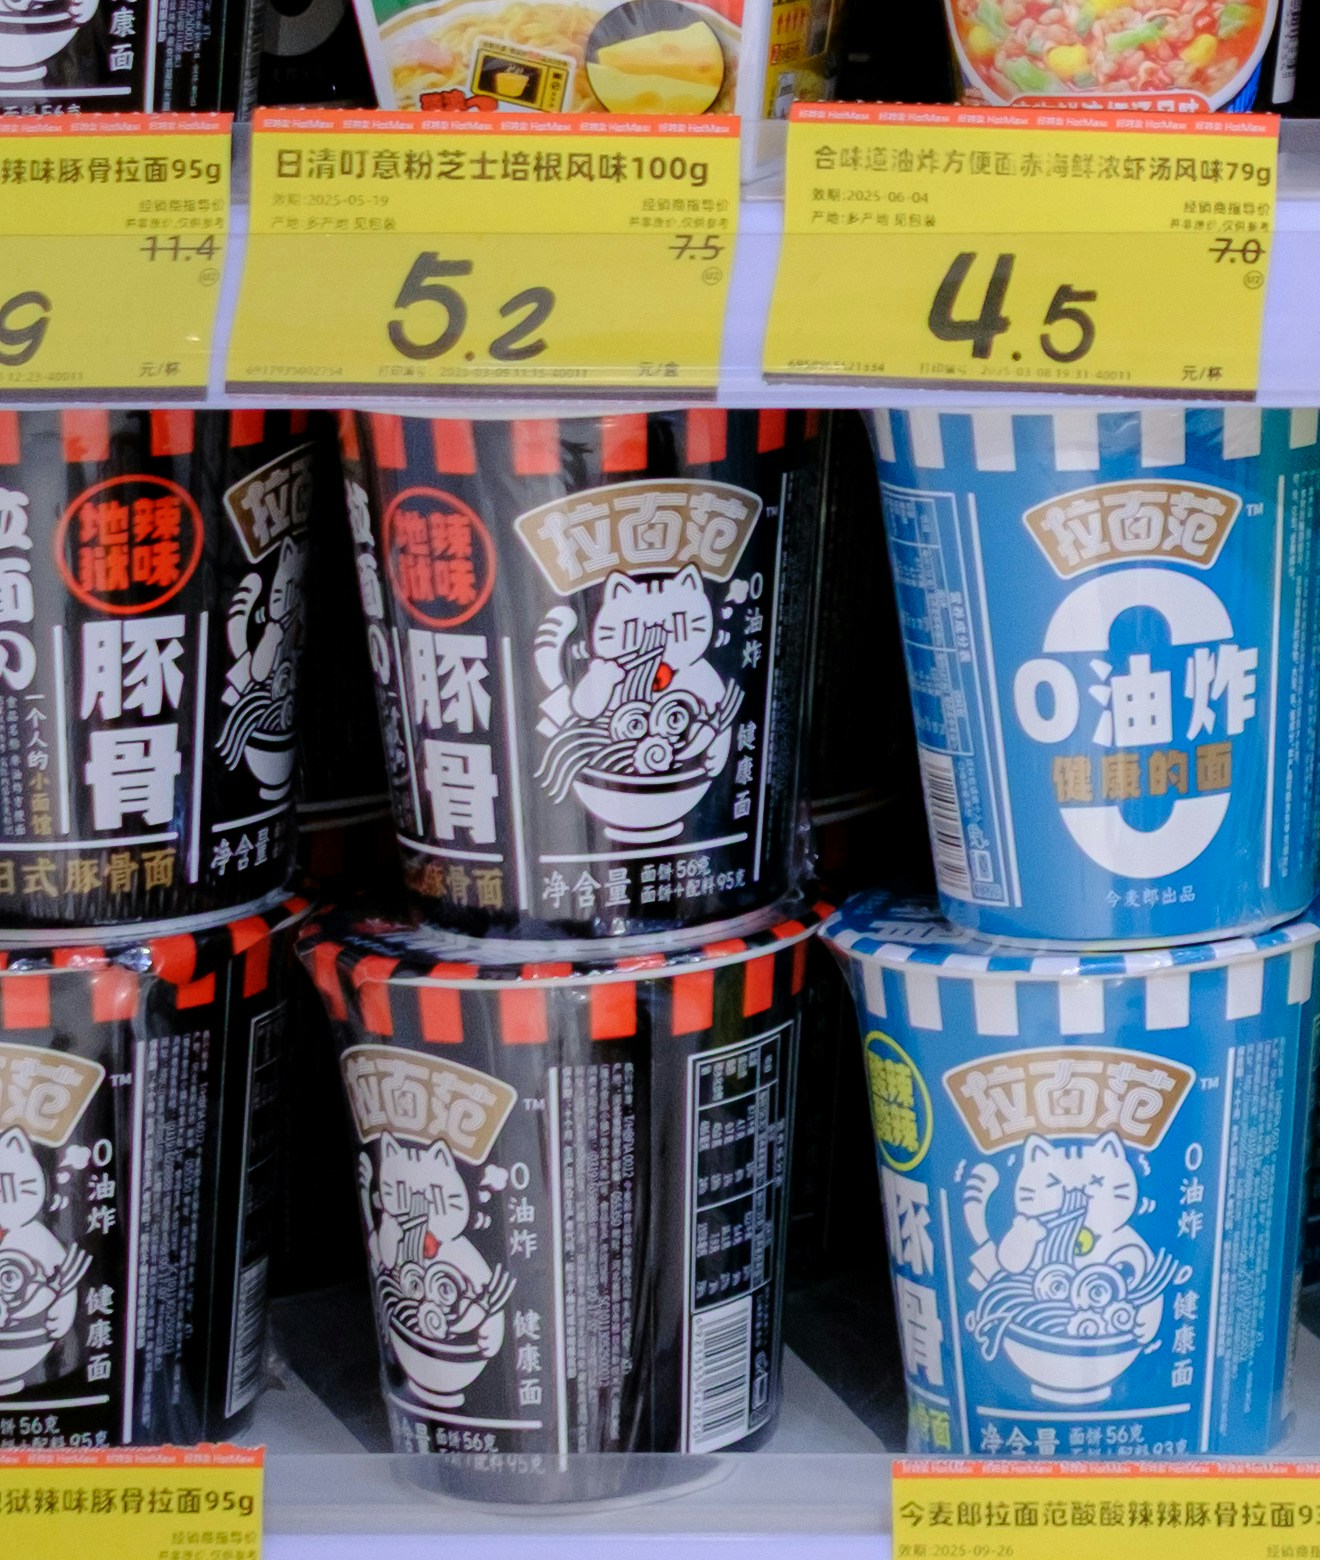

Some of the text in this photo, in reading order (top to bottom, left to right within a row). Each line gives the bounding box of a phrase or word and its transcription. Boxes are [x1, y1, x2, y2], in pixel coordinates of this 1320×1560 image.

[1, 154, 222, 184] 辣味豚骨拉面95g
[275, 149, 709, 188] 日清叮意粉芝士培根风味100g
[813, 145, 1272, 187] 合味道油炸方便面赤海鲜浓虾汤风味79g
[140, 236, 221, 262] 11.4
[668, 235, 724, 262] 7.5
[1209, 239, 1266, 265] 7.0
[386, 250, 557, 362] 5.2
[926, 252, 1098, 363] 4.5
[538, 492, 746, 580] 拉面范
[407, 631, 500, 845] 豚骨
[1052, 746, 1234, 802] 健康的面
[5, 1487, 255, 1516] 狱辣味豚骨拉面95g
